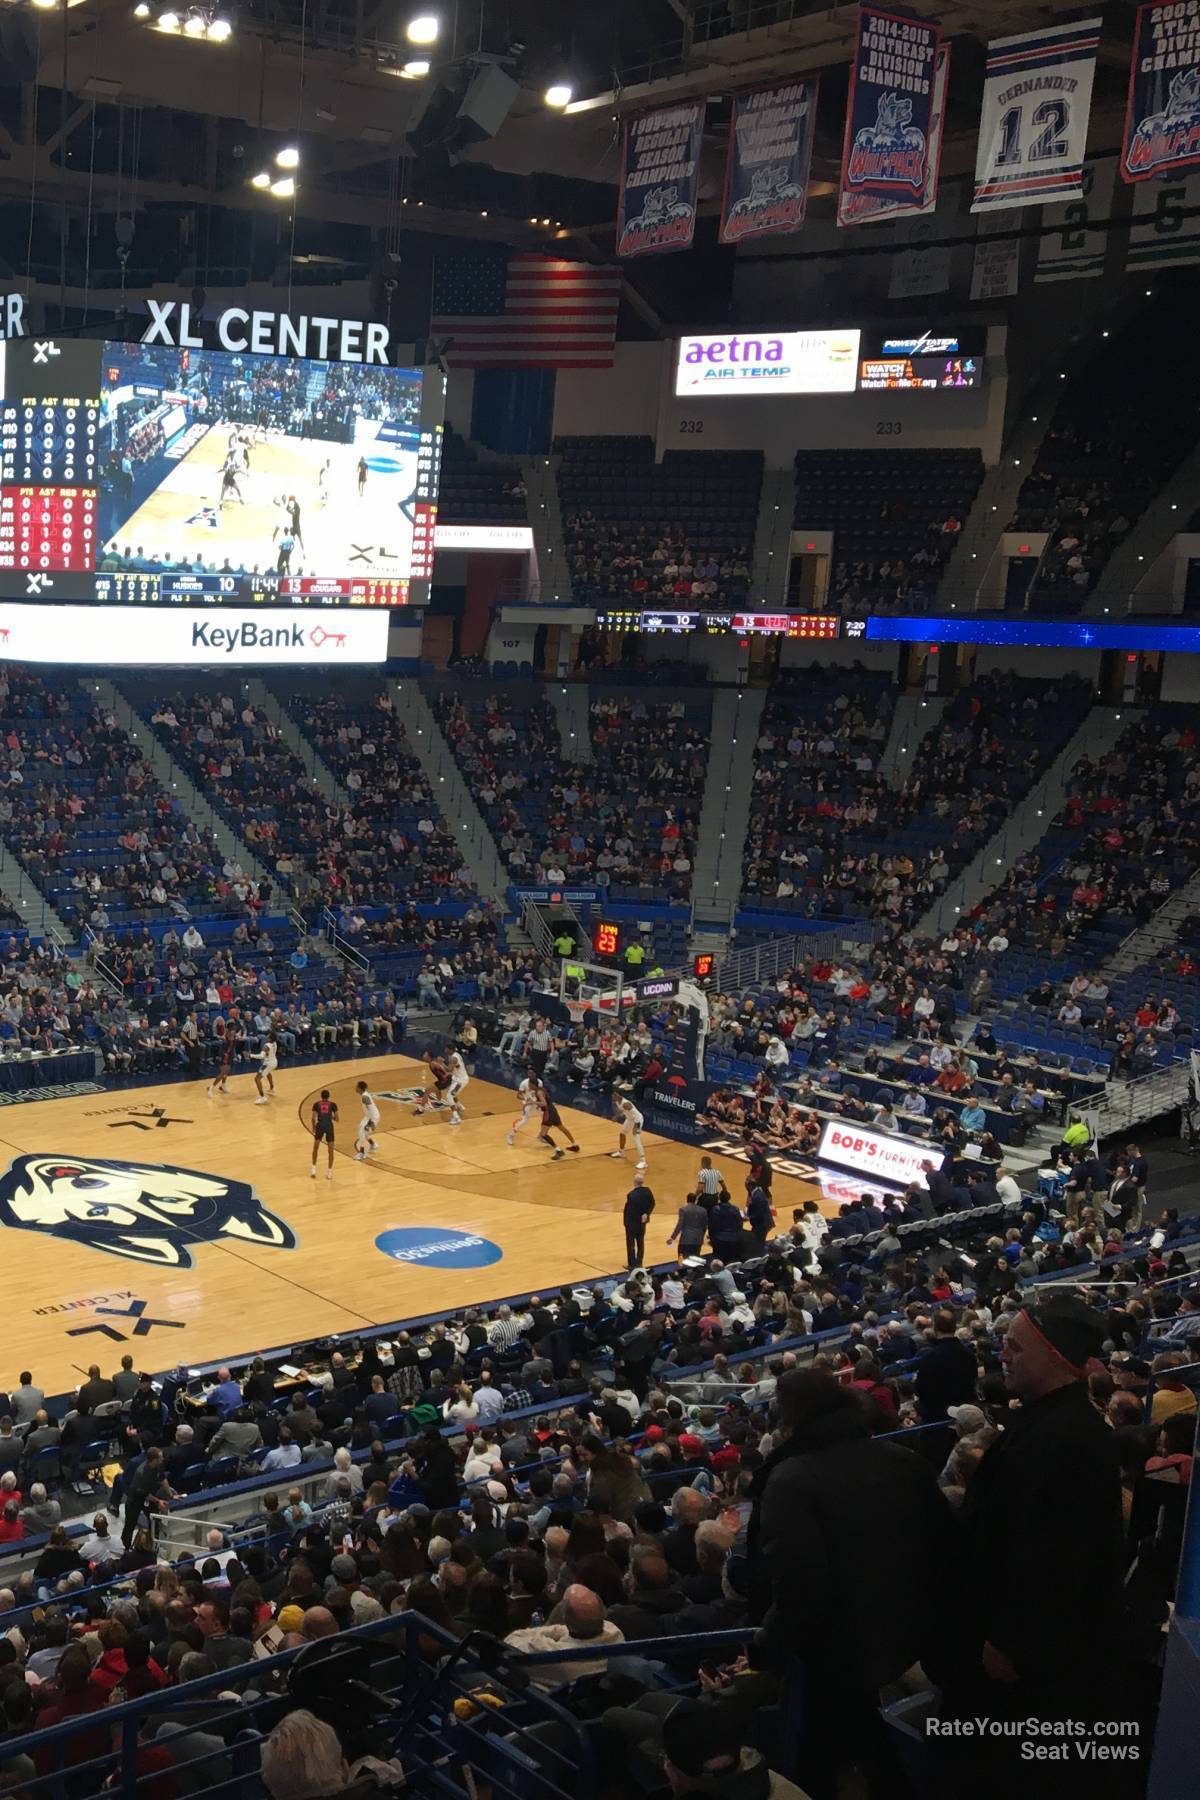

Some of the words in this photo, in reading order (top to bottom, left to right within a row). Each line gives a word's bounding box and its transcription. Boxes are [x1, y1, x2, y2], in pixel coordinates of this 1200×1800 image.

[862, 32, 934, 62] NORTHEAST
[870, 50, 923, 76] DIVISION
[860, 65, 929, 94] CHAMPIONS
[995, 98, 1070, 167] 12
[637, 145, 686, 169] SEASON
[626, 161, 695, 188] CHAMPIONS
[143, 299, 203, 348] XL
[219, 307, 389, 364] CENTER
[33, 341, 60, 363] XL
[685, 336, 783, 364] aetna
[705, 367, 736, 378] AIR
[739, 366, 791, 377] TEMP
[867, 364, 904, 373] WATCH
[861, 379, 937, 388] WatchForMeCT.org
[680, 421, 703, 433] 232
[876, 423, 901, 434] 233
[27, 573, 53, 593] XL
[220, 578, 234, 591] 10
[252, 578, 278, 592] 11:44
[288, 579, 301, 592] 13
[676, 615, 690, 625] 10
[706, 617, 730, 626] 11:44
[742, 617, 754, 627] 13
[846, 621, 866, 630] 7:20
[192, 622, 304, 652] KeyBank
[502, 640, 520, 648] 107
[599, 934, 615, 952] 23
[644, 983, 673, 995] UCONN
[654, 1092, 696, 1112] TRAVELERS
[831, 1132, 878, 1155] BOB'S
[880, 1150, 930, 1170] FURNITU
[395, 1236, 484, 1260] genius3D
[32, 1296, 109, 1316] CENTER
